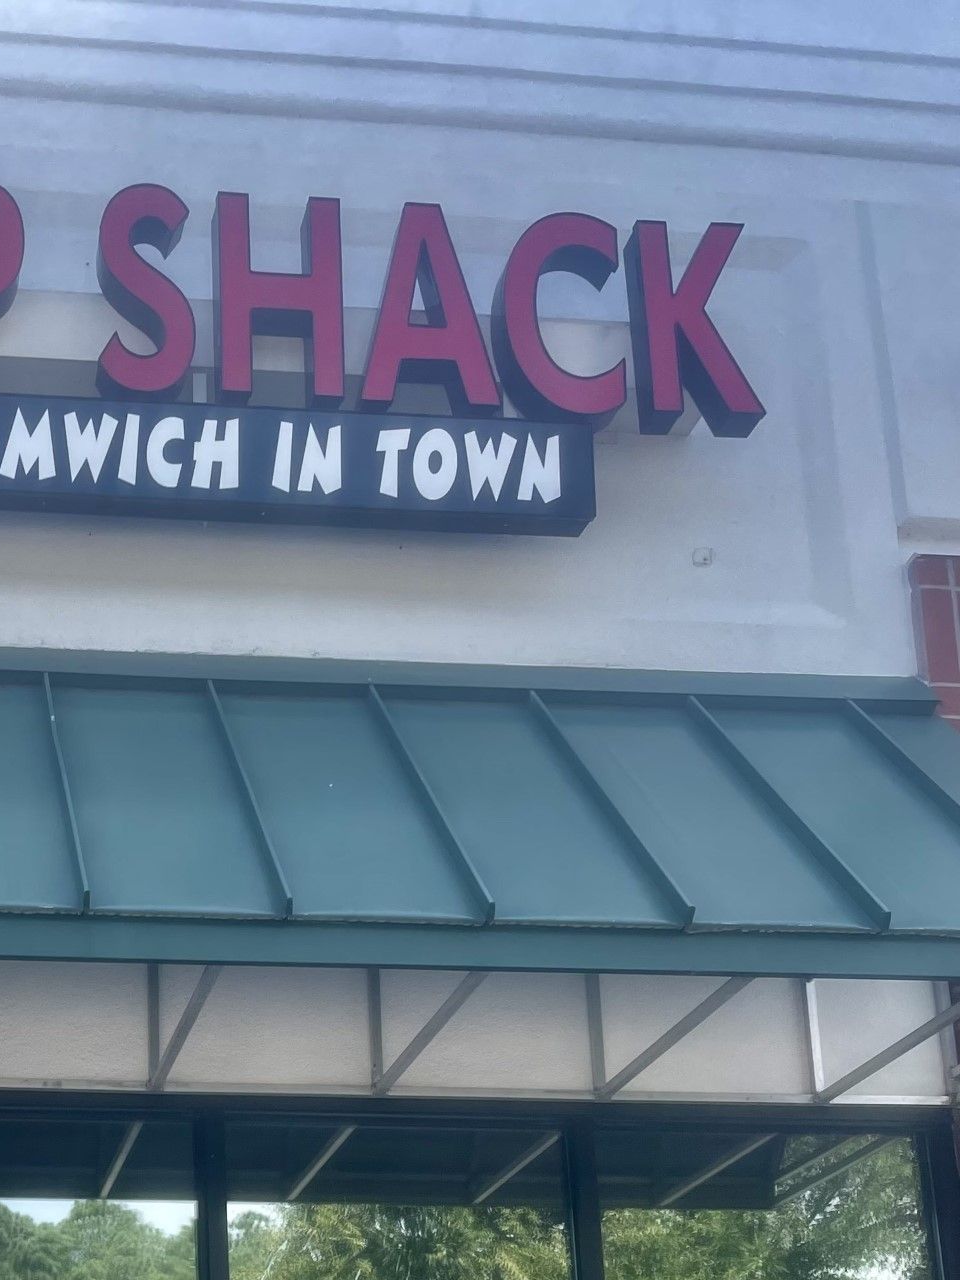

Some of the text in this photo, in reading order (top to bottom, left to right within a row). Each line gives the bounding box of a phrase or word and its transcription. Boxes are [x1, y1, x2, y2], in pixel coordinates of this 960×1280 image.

[97, 182, 767, 436] SHACK
[272, 421, 342, 495] IN
[376, 427, 561, 504] TOWN
